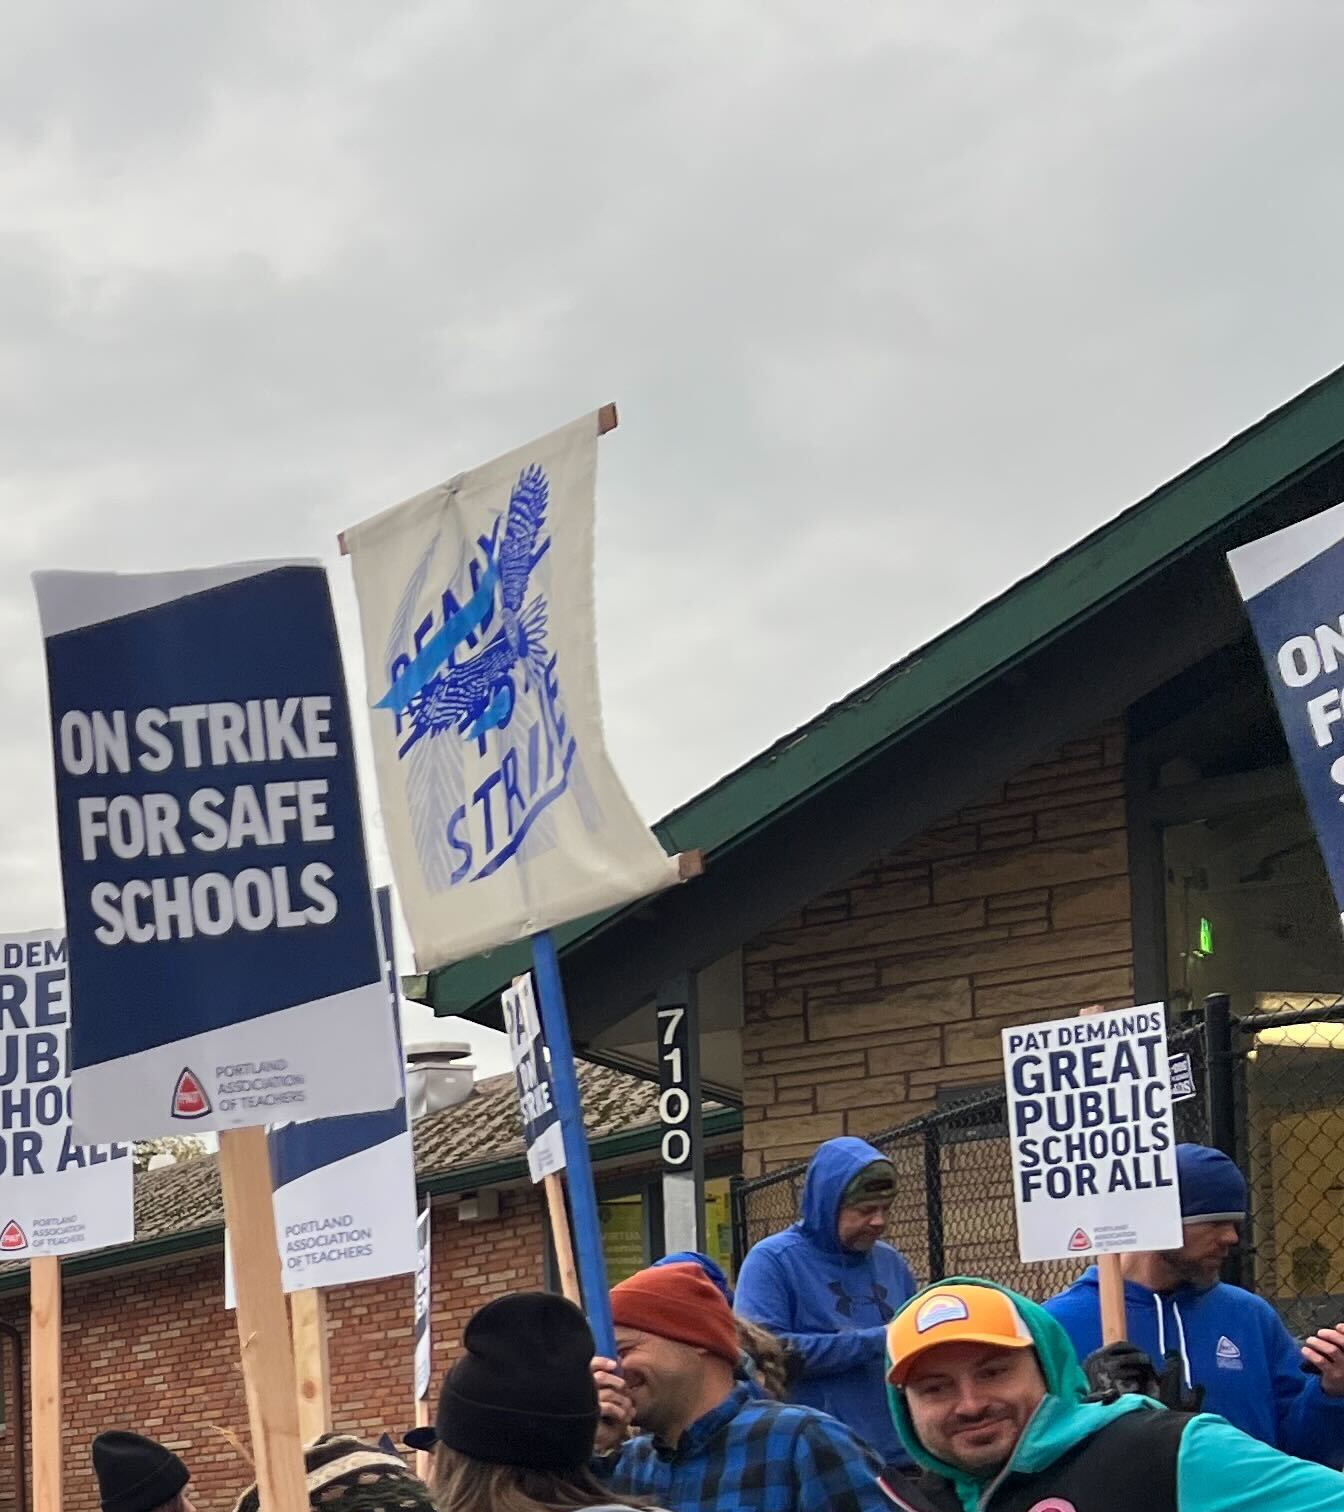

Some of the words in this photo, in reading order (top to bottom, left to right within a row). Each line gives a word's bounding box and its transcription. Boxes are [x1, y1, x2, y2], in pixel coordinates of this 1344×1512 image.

[60, 709, 131, 776] ON
[135, 696, 338, 773] STRIKE
[78, 792, 186, 862] FOR
[189, 778, 336, 852] SAFE
[91, 862, 338, 946] SCHOOLS
[1010, 1030, 1052, 1053] PAT
[1058, 1012, 1161, 1046] DEMANDS
[657, 1008, 691, 1165] 7100
[1012, 1035, 1162, 1096] GREAT
[1015, 1082, 1167, 1137] PUBLIC
[1019, 1121, 1170, 1168] SCHOOLS
[1020, 1163, 1098, 1203] FOR
[1108, 1154, 1173, 1193] ALL
[285, 1214, 353, 1238] PORTLAND
[287, 1228, 371, 1253] ASSOCIATION
[287, 1255, 302, 1269] OF
[304, 1243, 373, 1265] TEACHERS
